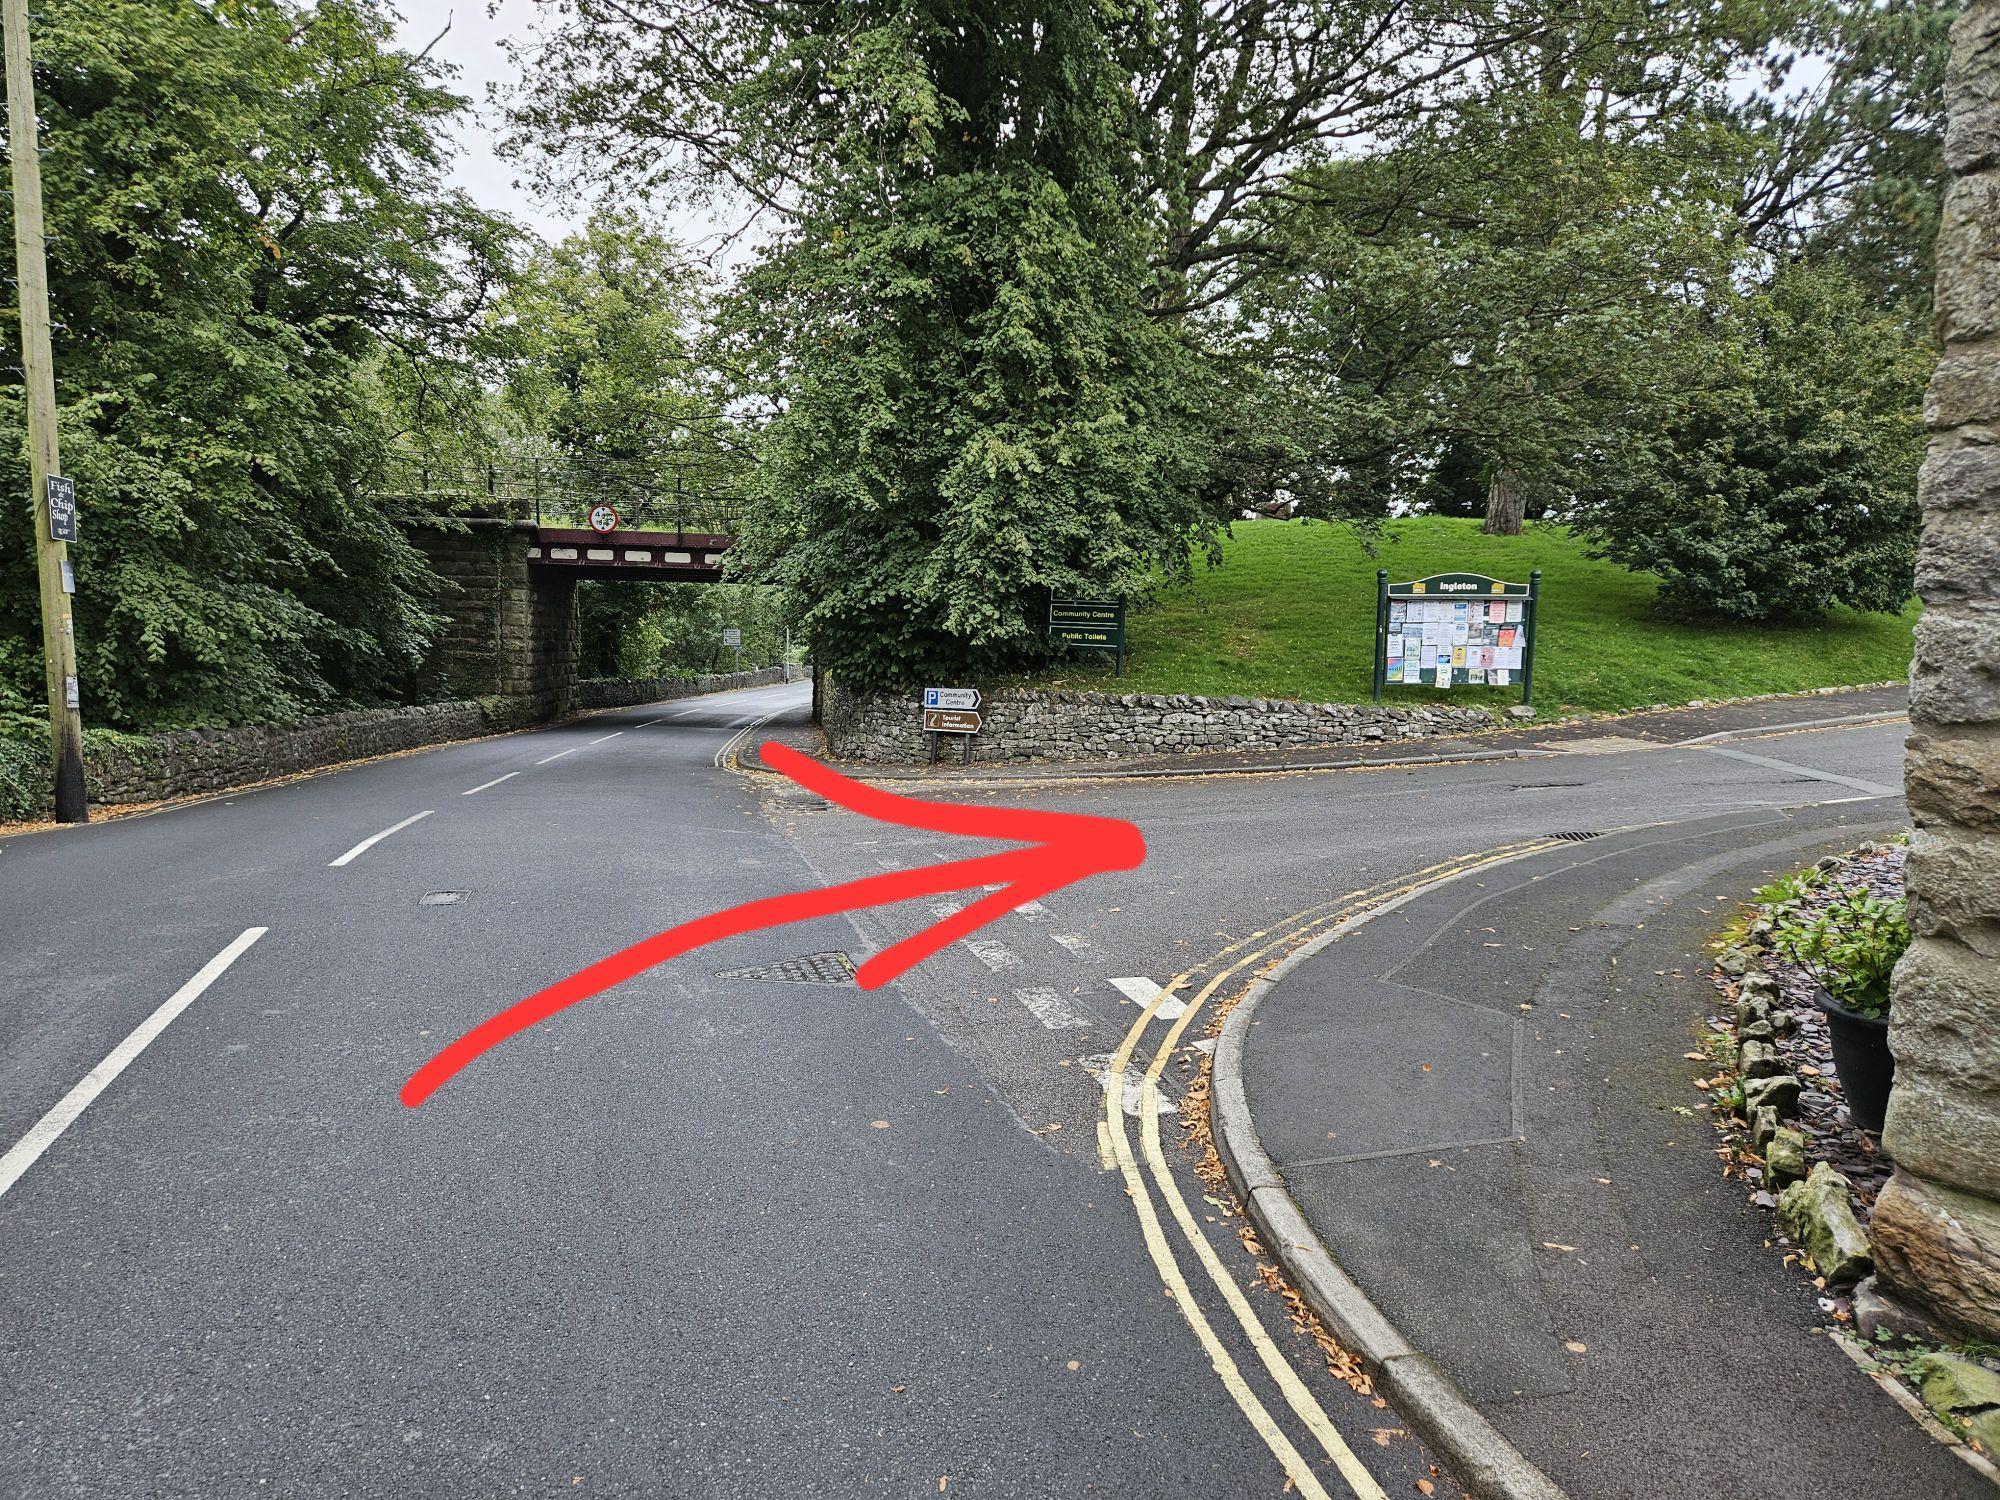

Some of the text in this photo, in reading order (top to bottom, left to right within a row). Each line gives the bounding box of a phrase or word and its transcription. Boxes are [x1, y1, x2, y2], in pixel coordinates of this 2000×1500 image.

[50, 481, 72, 494] Fish
[51, 497, 74, 515] Chip
[52, 509, 69, 526] Shop
[1440, 582, 1477, 592] Ingleton
[1053, 610, 1091, 619] Community
[1061, 632, 1107, 641] Public Toilets
[928, 692, 937, 704] P
[940, 691, 972, 699] Community
